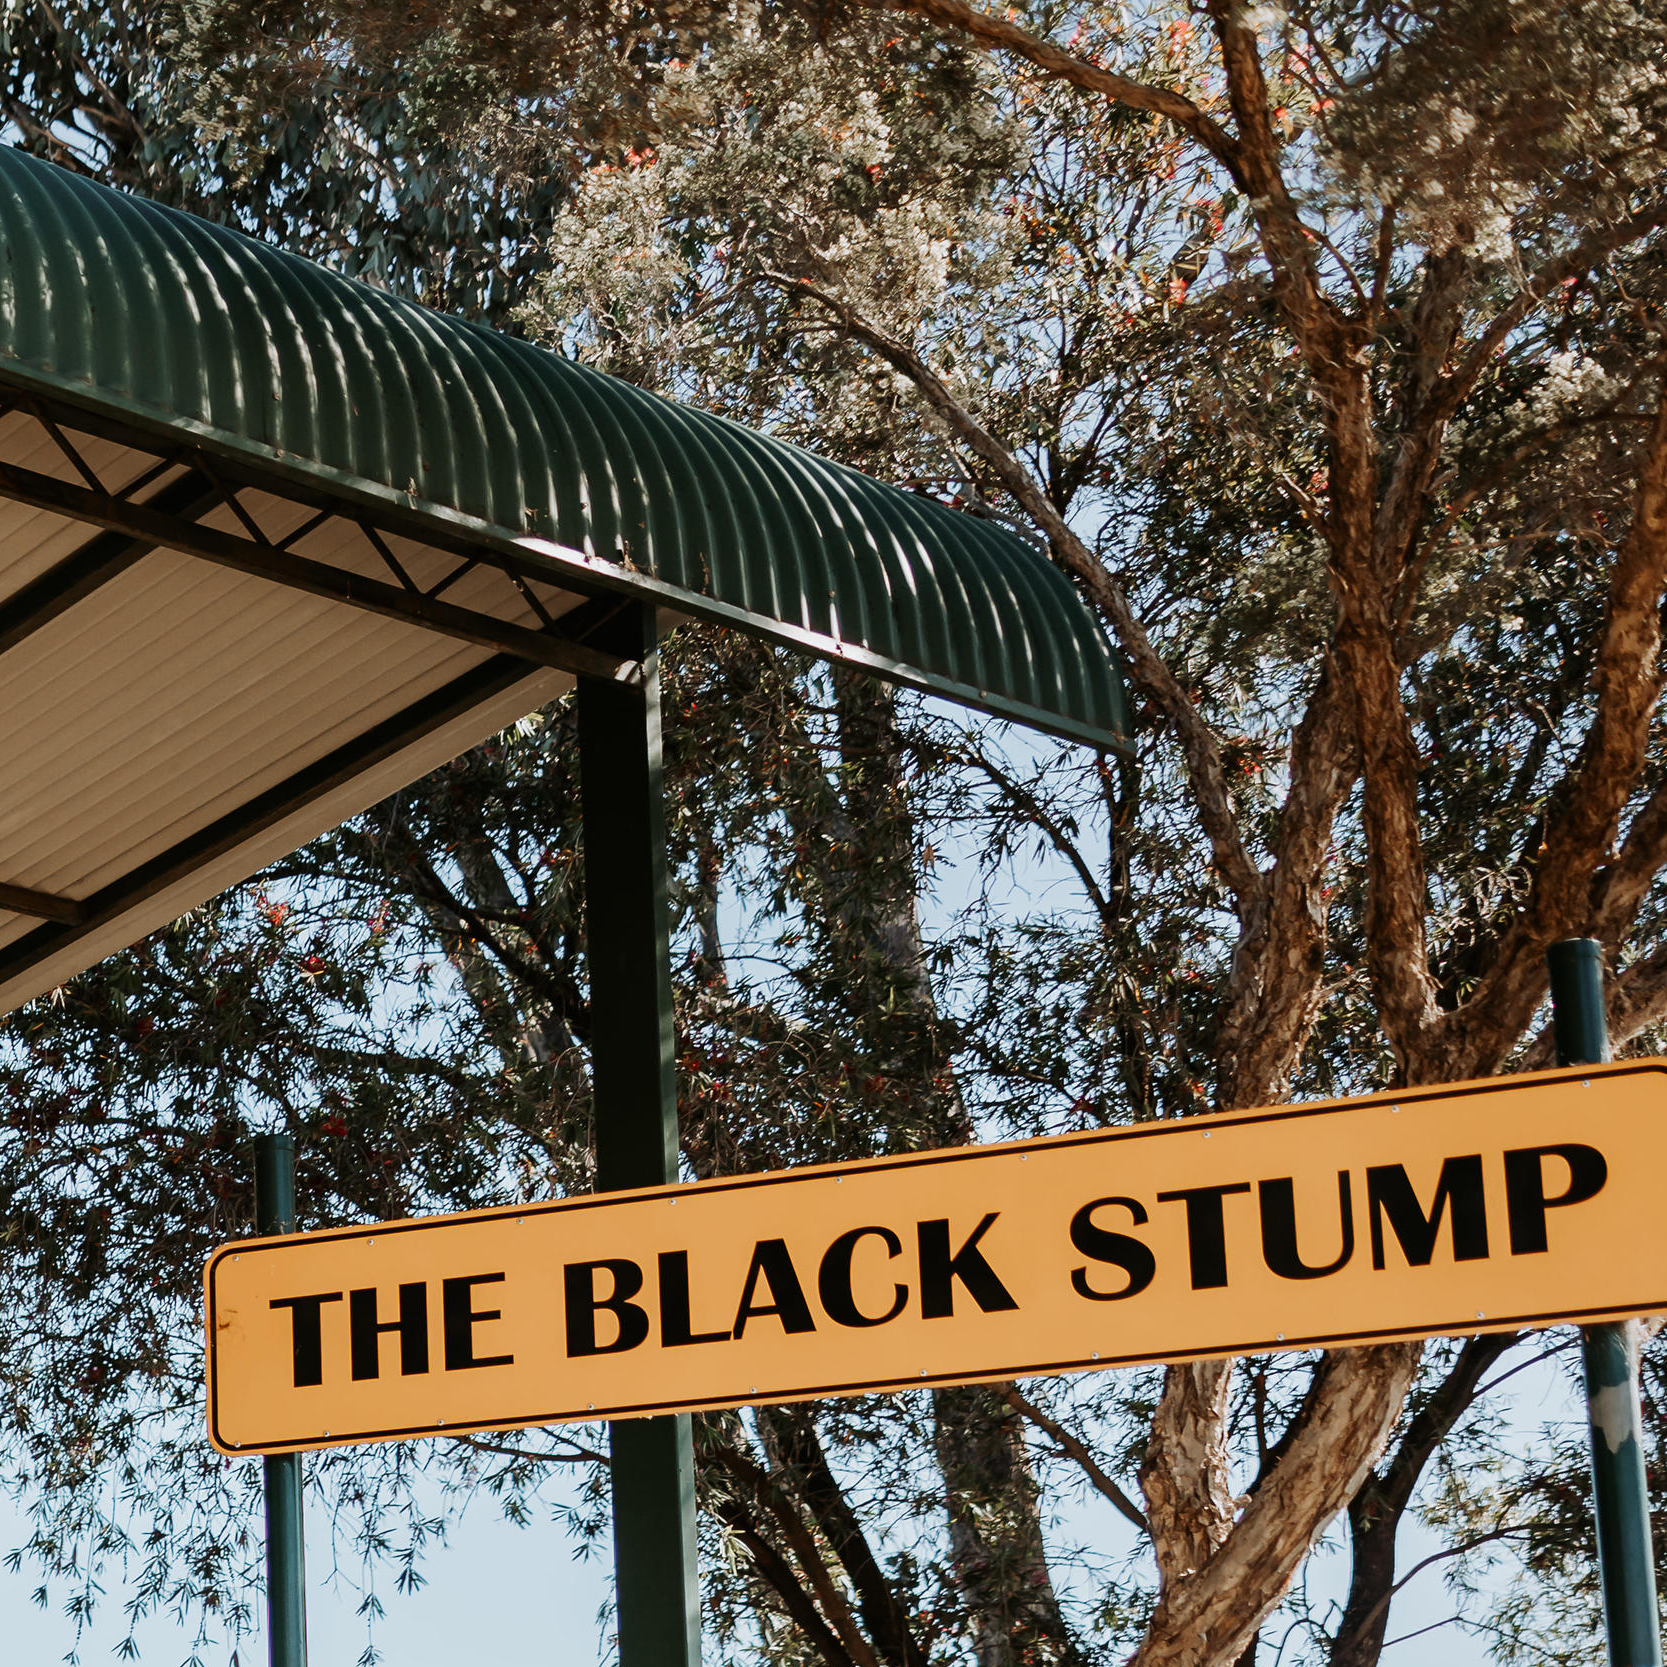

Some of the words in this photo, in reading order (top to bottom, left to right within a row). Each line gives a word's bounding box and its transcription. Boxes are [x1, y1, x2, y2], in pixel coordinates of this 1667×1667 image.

[270, 1272, 514, 1387] THE
[564, 1212, 1019, 1358] BLACK
[1070, 1144, 1607, 1301] STUMP
